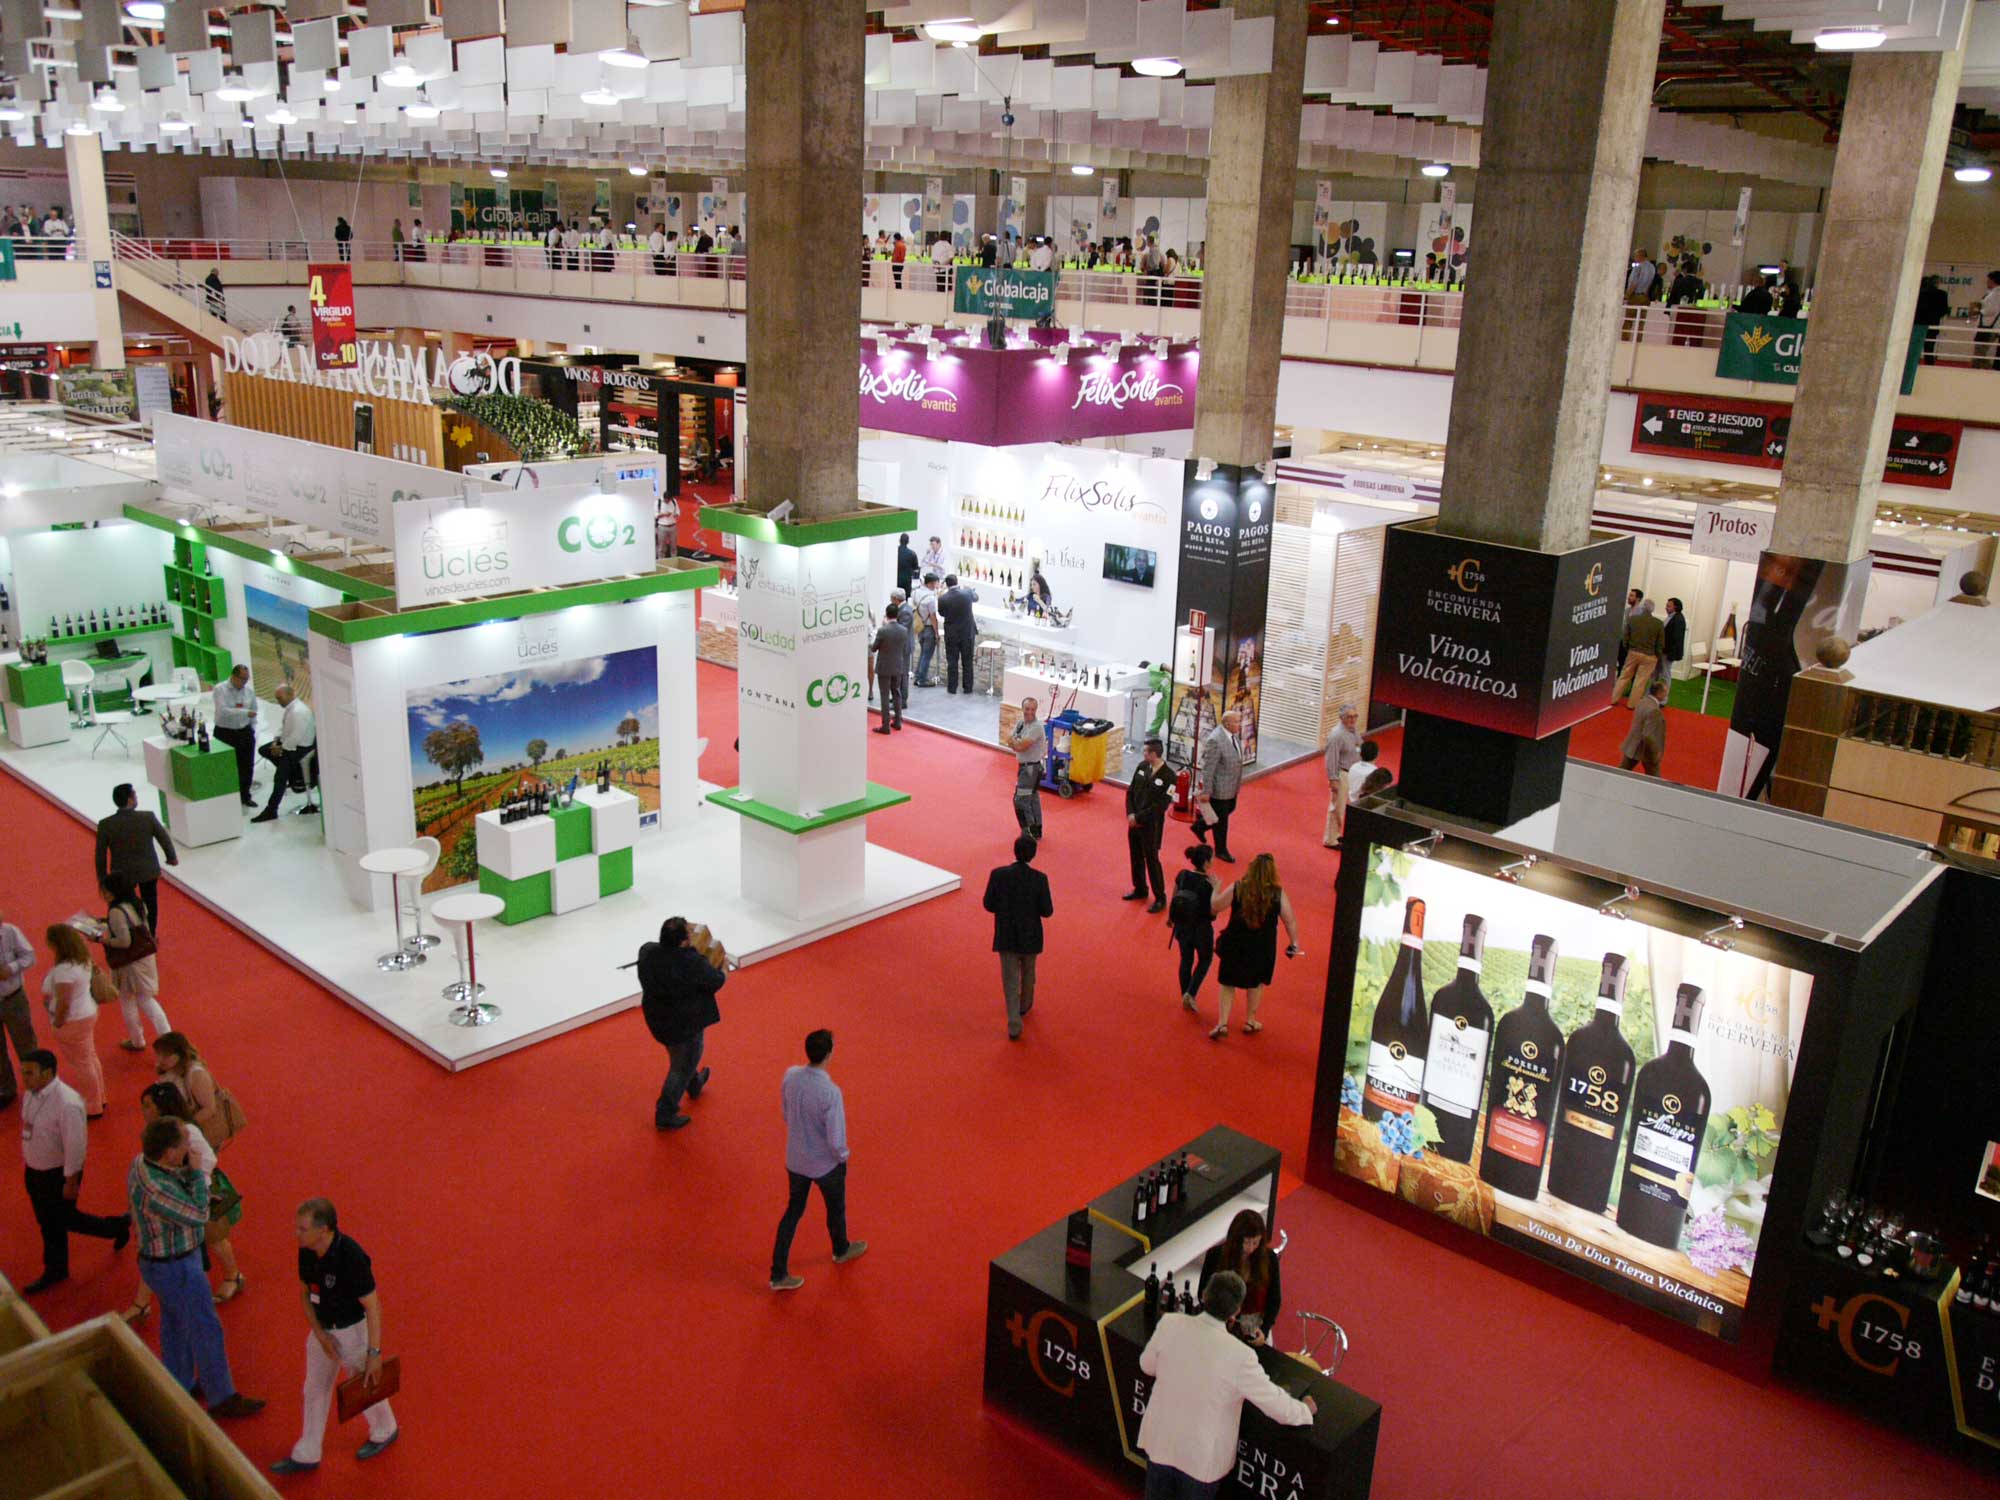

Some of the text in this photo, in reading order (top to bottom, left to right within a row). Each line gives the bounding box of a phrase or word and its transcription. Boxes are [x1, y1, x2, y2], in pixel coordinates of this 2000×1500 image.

[309, 275, 327, 306] 4
[984, 280, 1049, 304] Globalcaja
[313, 306, 352, 317] VIRGILIO
[222, 335, 257, 376] DO
[321, 343, 356, 363] Calle 10
[563, 366, 650, 390] VINOS & BODEGAS
[921, 399, 957, 413] avantis
[1154, 394, 1183, 407] avantis
[1668, 409, 1763, 428] 1 ENEO 2 HESIODO
[1353, 480, 1376, 489] BODEGAS
[1186, 521, 1231, 538] PAGOS
[1239, 524, 1269, 540] PAGOS
[1707, 511, 1757, 536] Protos
[1190, 534, 1220, 545] DEL REY
[424, 575, 511, 598] vinosdeucles.com
[1464, 571, 1486, 582] 1758
[1428, 589, 1502, 610] ENCOMIENDA
[1573, 596, 1608, 613] ENCOMIENDA
[801, 624, 866, 645] vinosdeucles.com
[1430, 633, 1491, 667] Vinos
[1570, 643, 1600, 669] Vinos
[1399, 653, 1519, 699] Volcánicos
[1551, 664, 1608, 700] Volcánicos
[1508, 1055, 1540, 1072] POKER
[1568, 1076, 1620, 1114] 1758
[1639, 1114, 1696, 1142] Almagro
[1565, 1238, 1583, 1253] De
[1584, 1246, 1611, 1266] Una
[1615, 1257, 1655, 1284] Tierra
[1658, 1276, 1724, 1315] Volcánica
[1861, 1320, 1922, 1360] 1758
[1044, 1338, 1091, 1380] 1758
